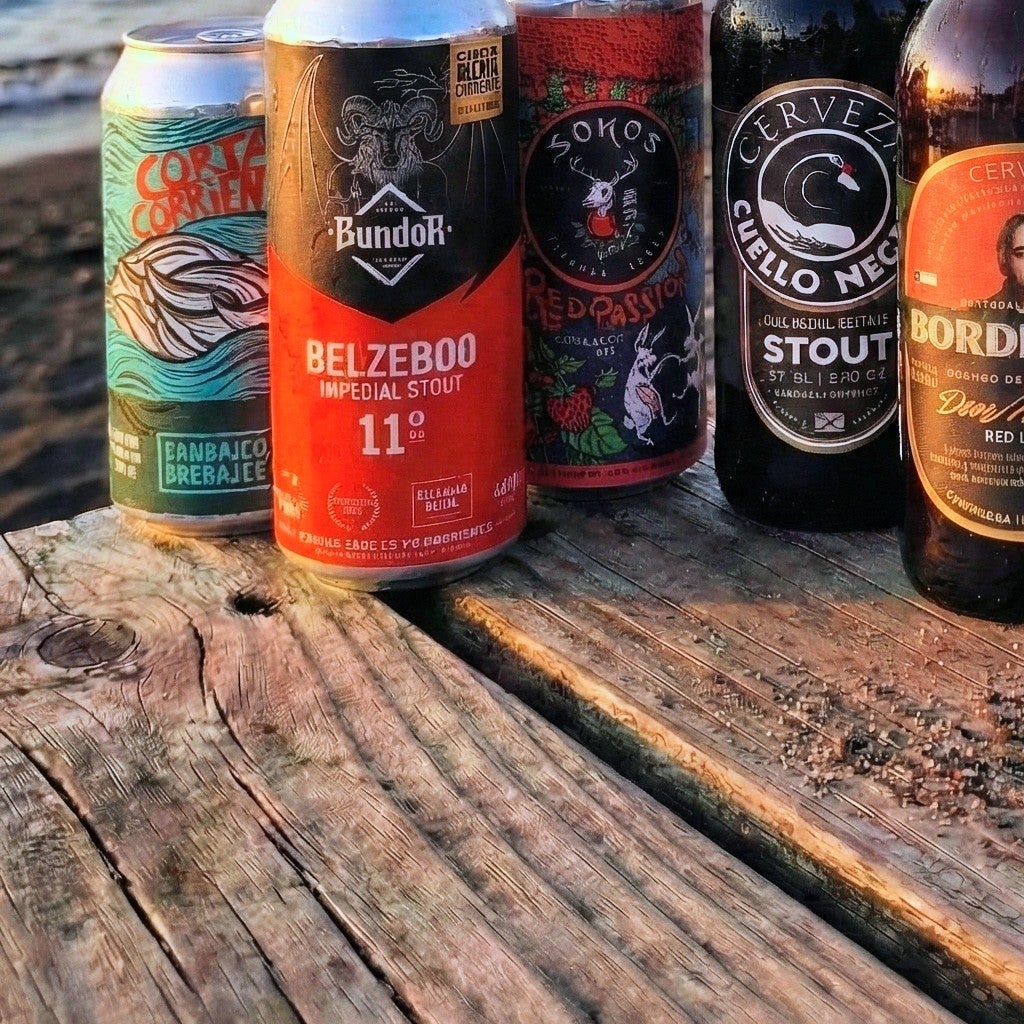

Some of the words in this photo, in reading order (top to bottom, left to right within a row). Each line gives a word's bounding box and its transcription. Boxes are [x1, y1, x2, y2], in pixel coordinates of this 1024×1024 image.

[739, 96, 896, 164] CERVEZ
[734, 199, 821, 295] CUELLO
[834, 226, 898, 294] NEG
[306, 332, 476, 378] BELZEBOO
[763, 332, 893, 366] STOUT
[407, 374, 464, 399] STOUT
[984, 429, 1015, 444] RED
